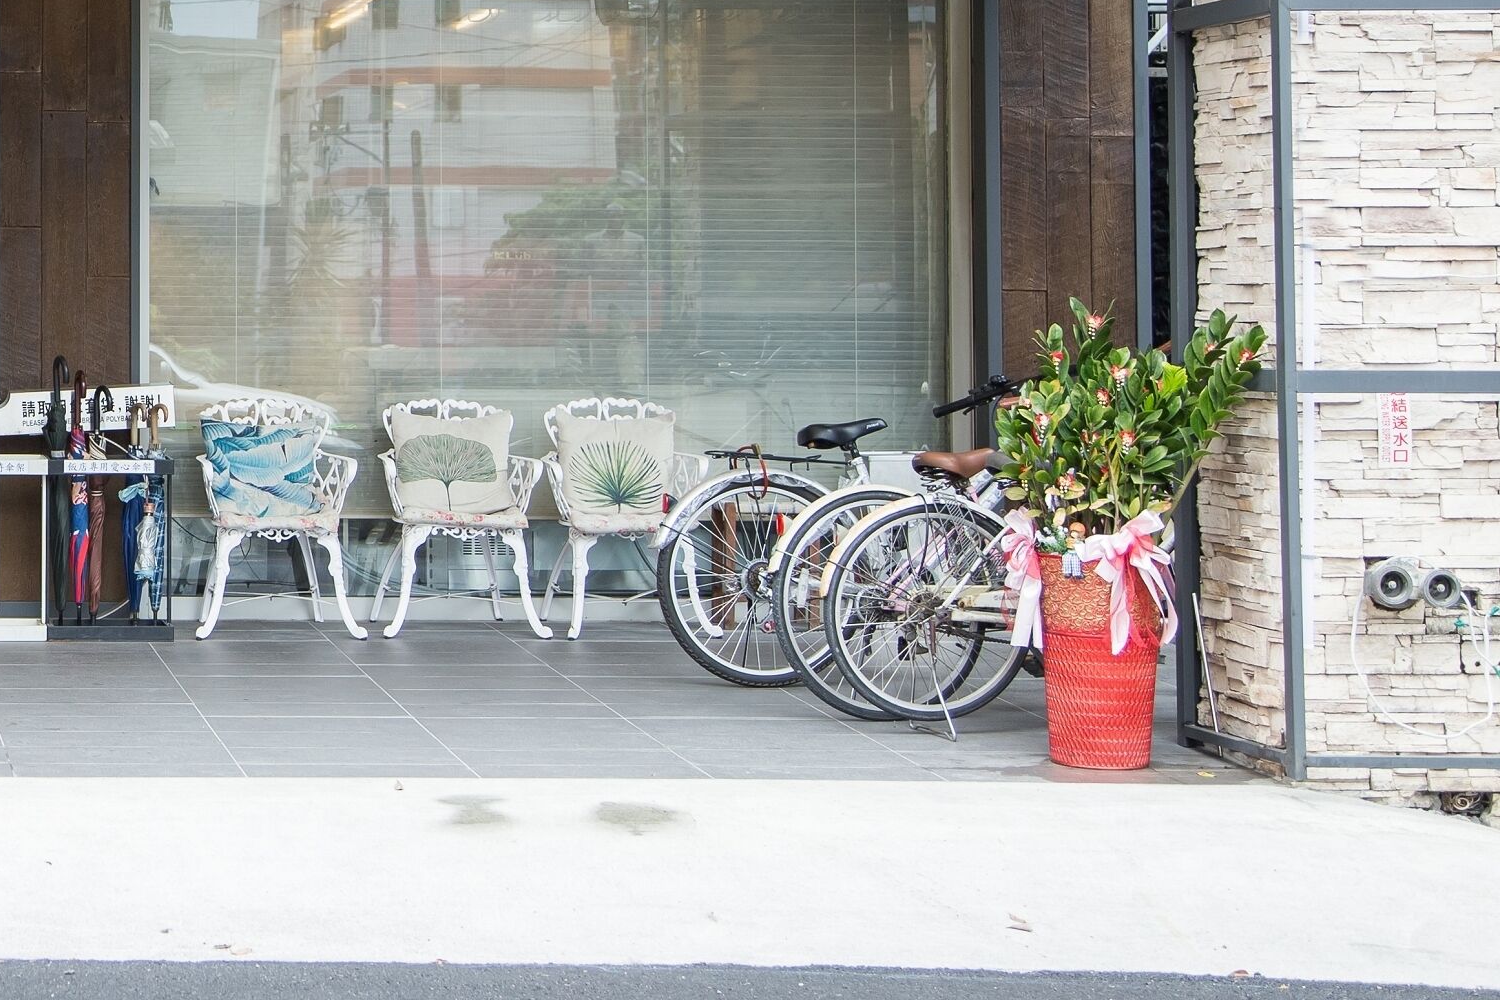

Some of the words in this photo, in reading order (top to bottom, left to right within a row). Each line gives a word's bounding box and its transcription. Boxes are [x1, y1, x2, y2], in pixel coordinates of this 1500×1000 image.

[22, 393, 162, 418] 請取套袋,謝謝!
[22, 418, 45, 427] PLEASE
[1391, 391, 1408, 462] 結送水口
